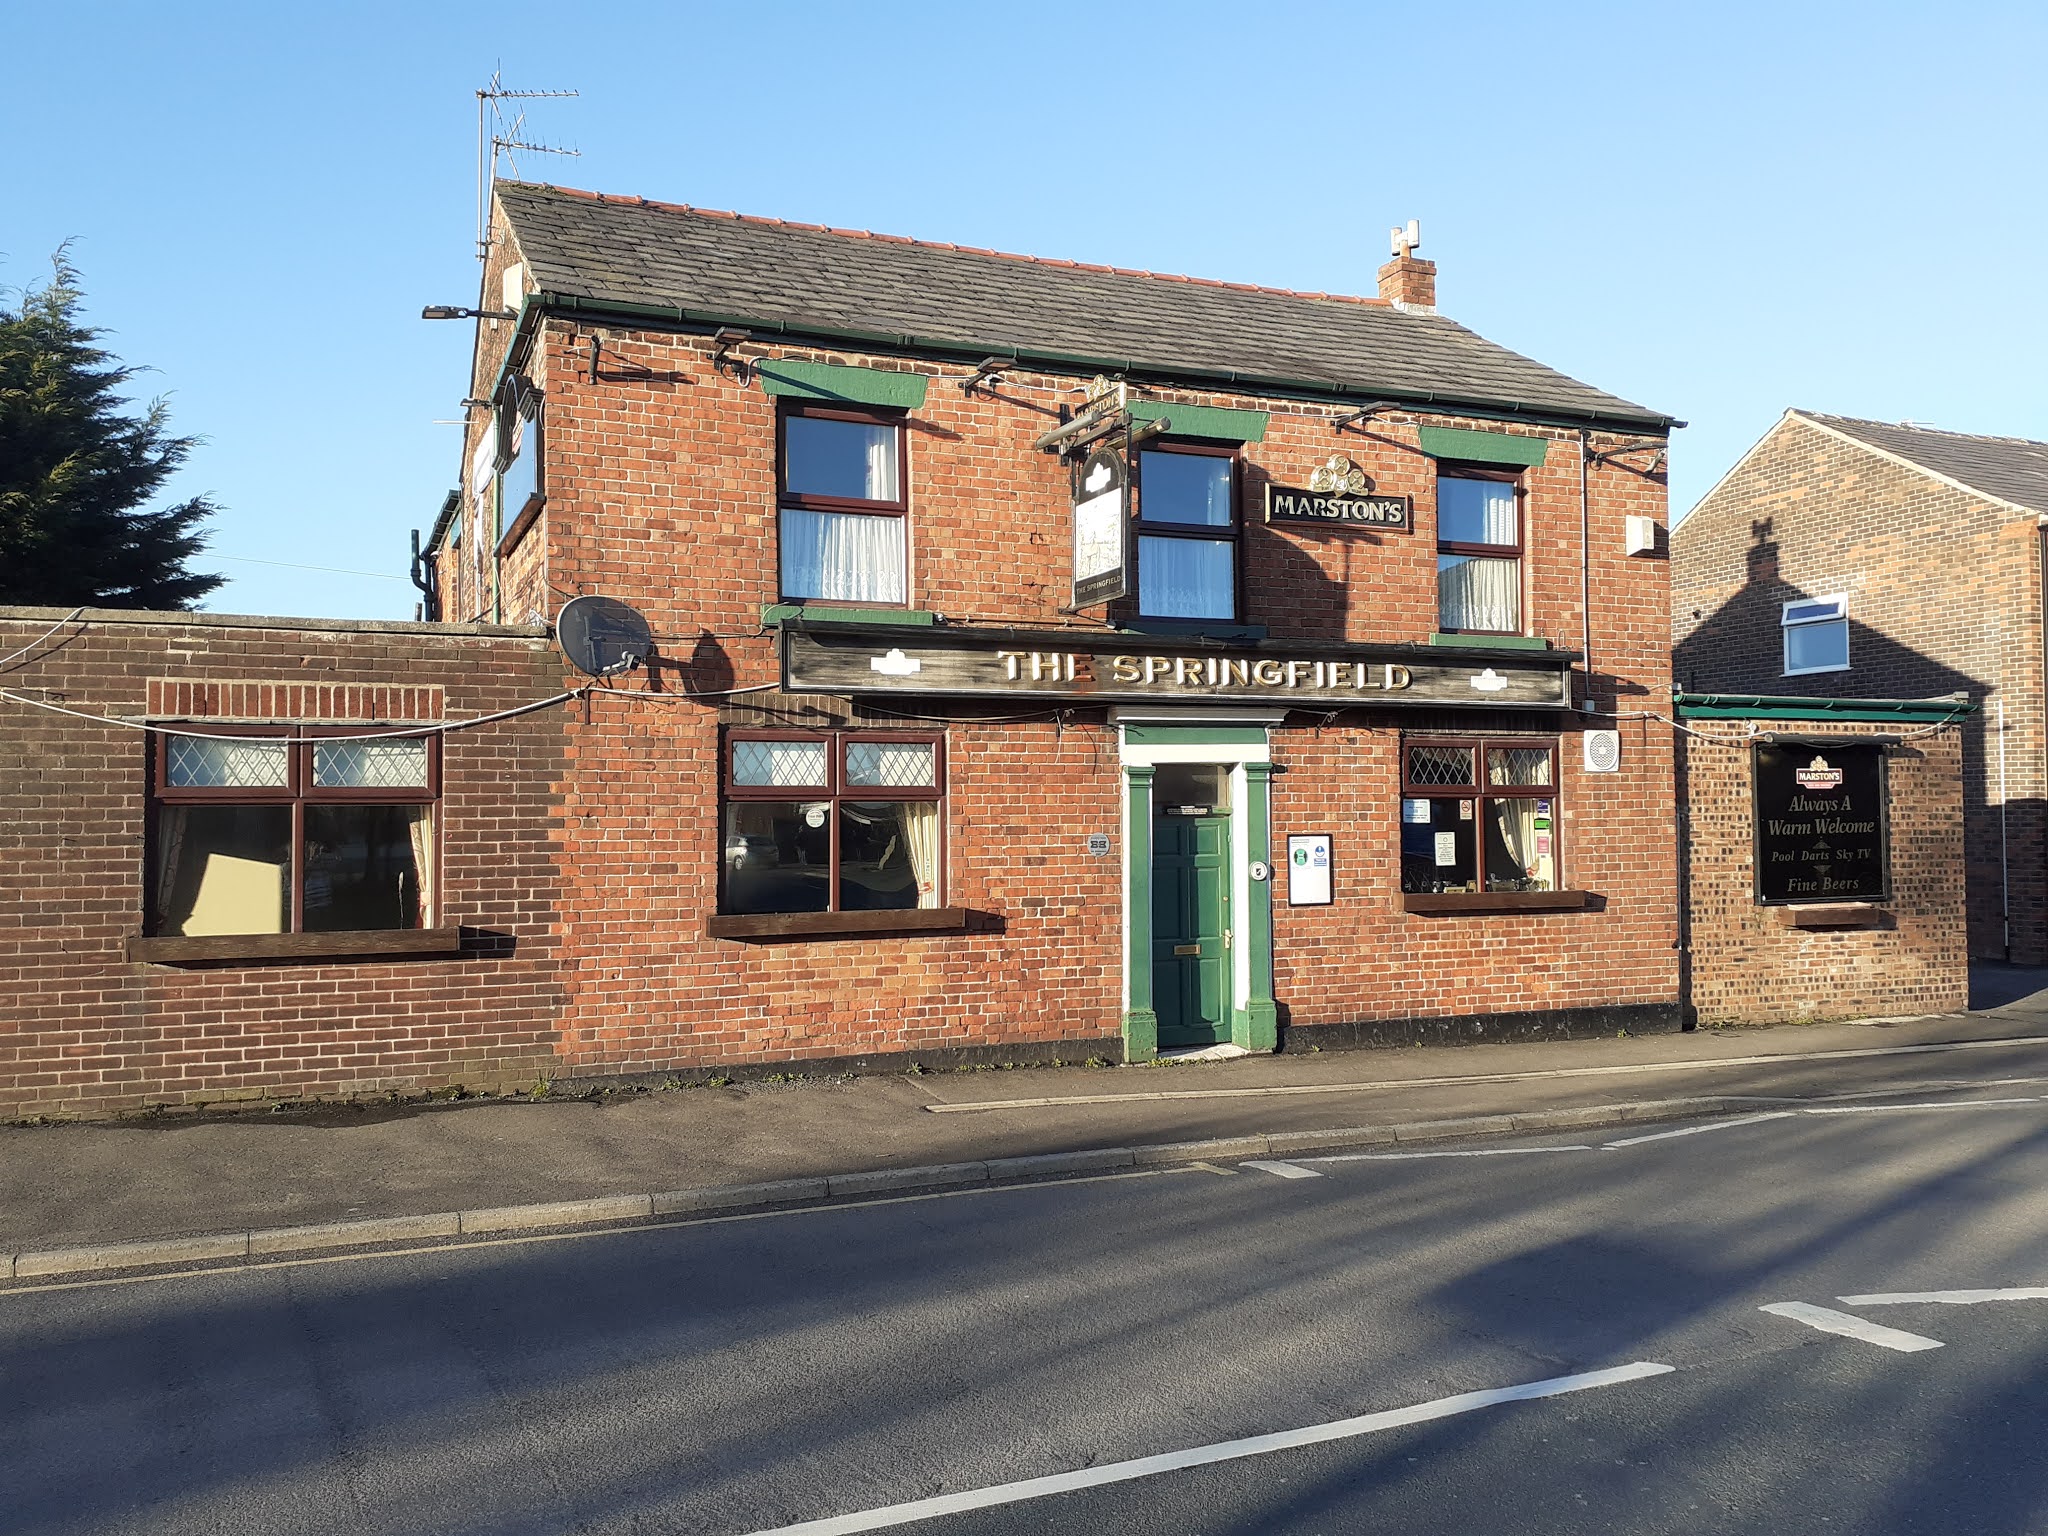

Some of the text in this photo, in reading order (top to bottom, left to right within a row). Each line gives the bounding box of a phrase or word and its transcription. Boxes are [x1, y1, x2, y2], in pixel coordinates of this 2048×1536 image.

[1274, 495, 1403, 522] MARSTON'S
[1076, 575, 1121, 594] THE SPRINGFIELD
[997, 651, 1413, 690] THE SPRINGFIELD
[1799, 772, 1839, 780] MARSTON'S
[1788, 795, 1852, 816] Always A
[1768, 817, 1875, 836] Warm Welcome
[1771, 848, 1872, 862] Pool Darts Sky TV
[1787, 877, 1860, 892] Fine Beers
